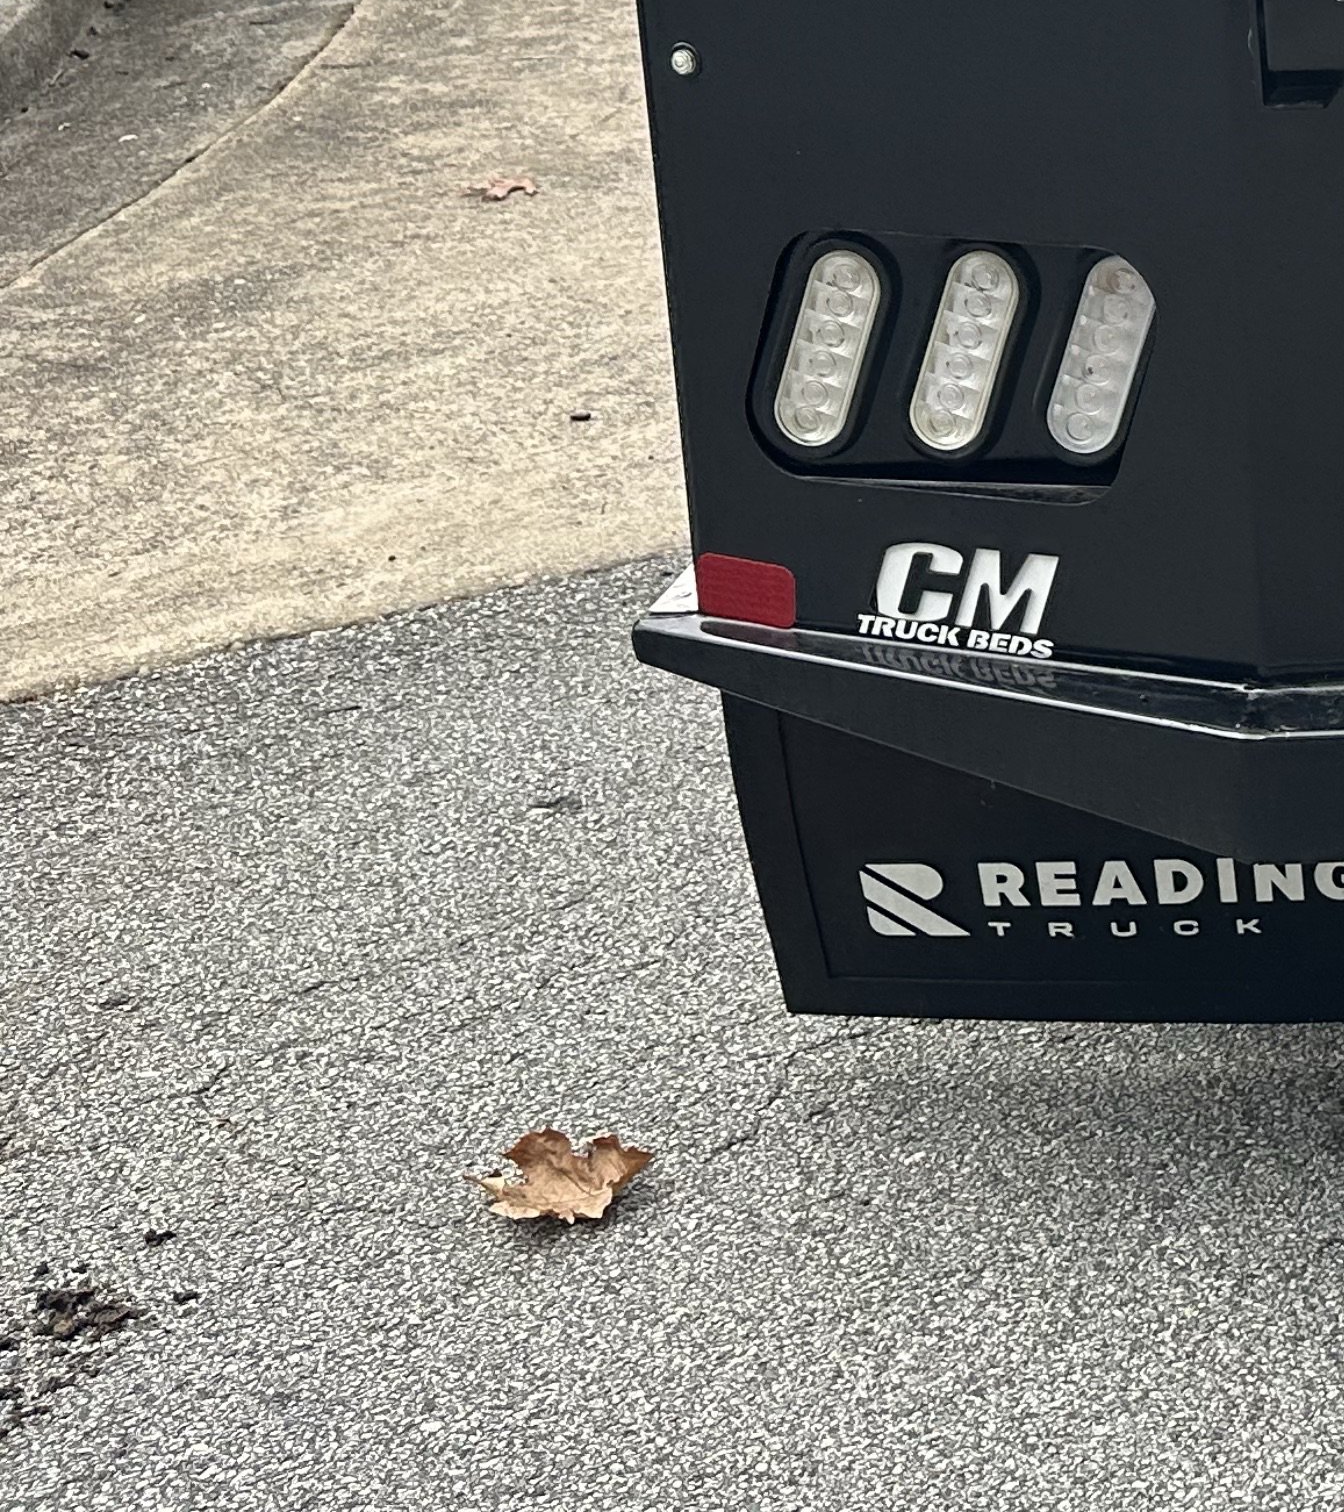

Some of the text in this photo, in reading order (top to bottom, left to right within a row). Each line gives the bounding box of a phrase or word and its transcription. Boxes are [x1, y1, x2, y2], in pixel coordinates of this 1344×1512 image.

[876, 542, 1060, 635] CM
[857, 613, 1055, 659] TRUCK BEDS
[987, 918, 1262, 938] TRUCK
